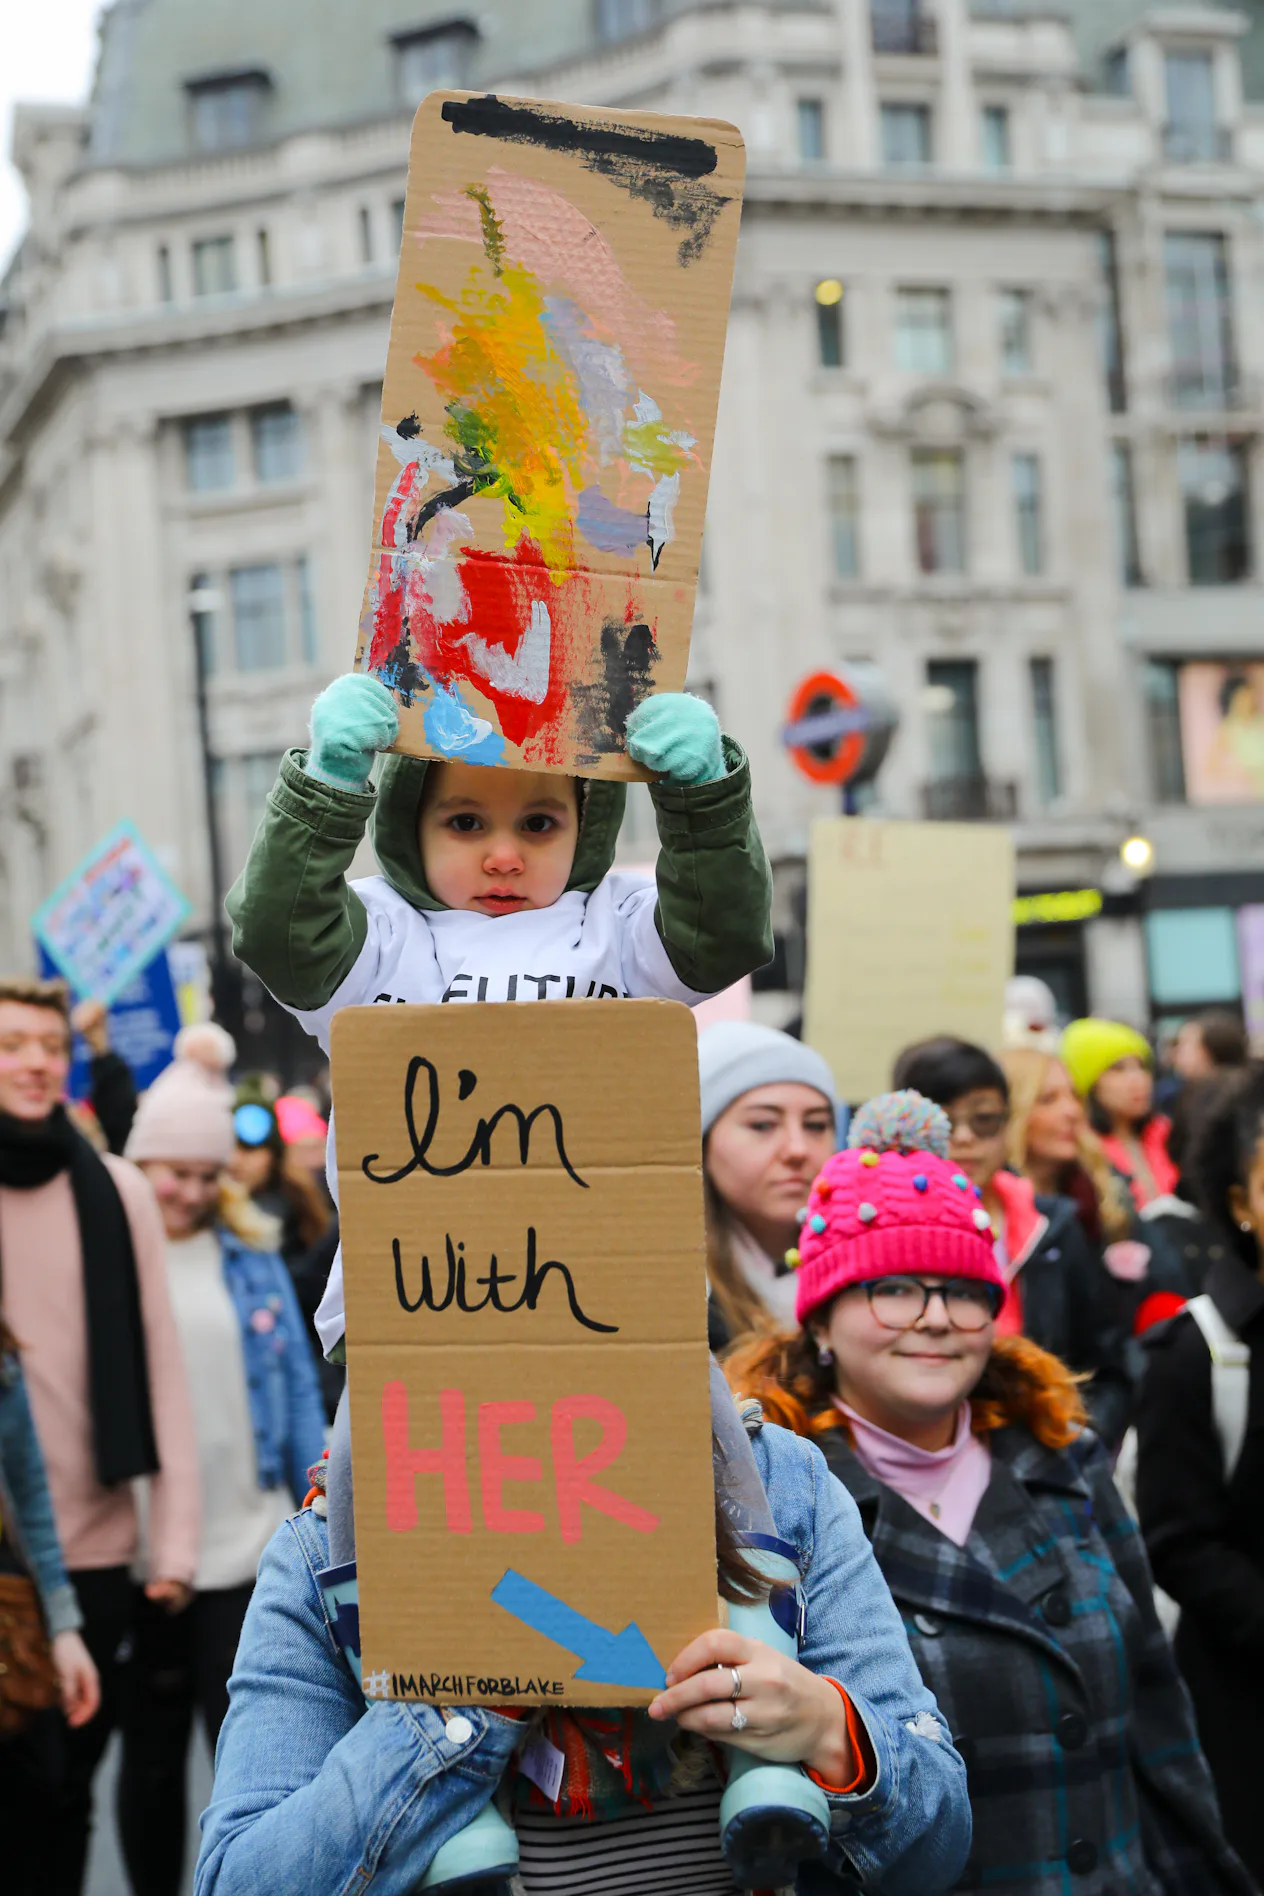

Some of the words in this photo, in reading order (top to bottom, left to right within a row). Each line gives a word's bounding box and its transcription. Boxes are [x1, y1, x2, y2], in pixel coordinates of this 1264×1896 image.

[440, 974, 632, 1004] FUTU
[362, 1056, 590, 1188] I'm
[381, 1380, 661, 1546] HER
[363, 1669, 565, 1698] #IMARCHFORBLAKE
